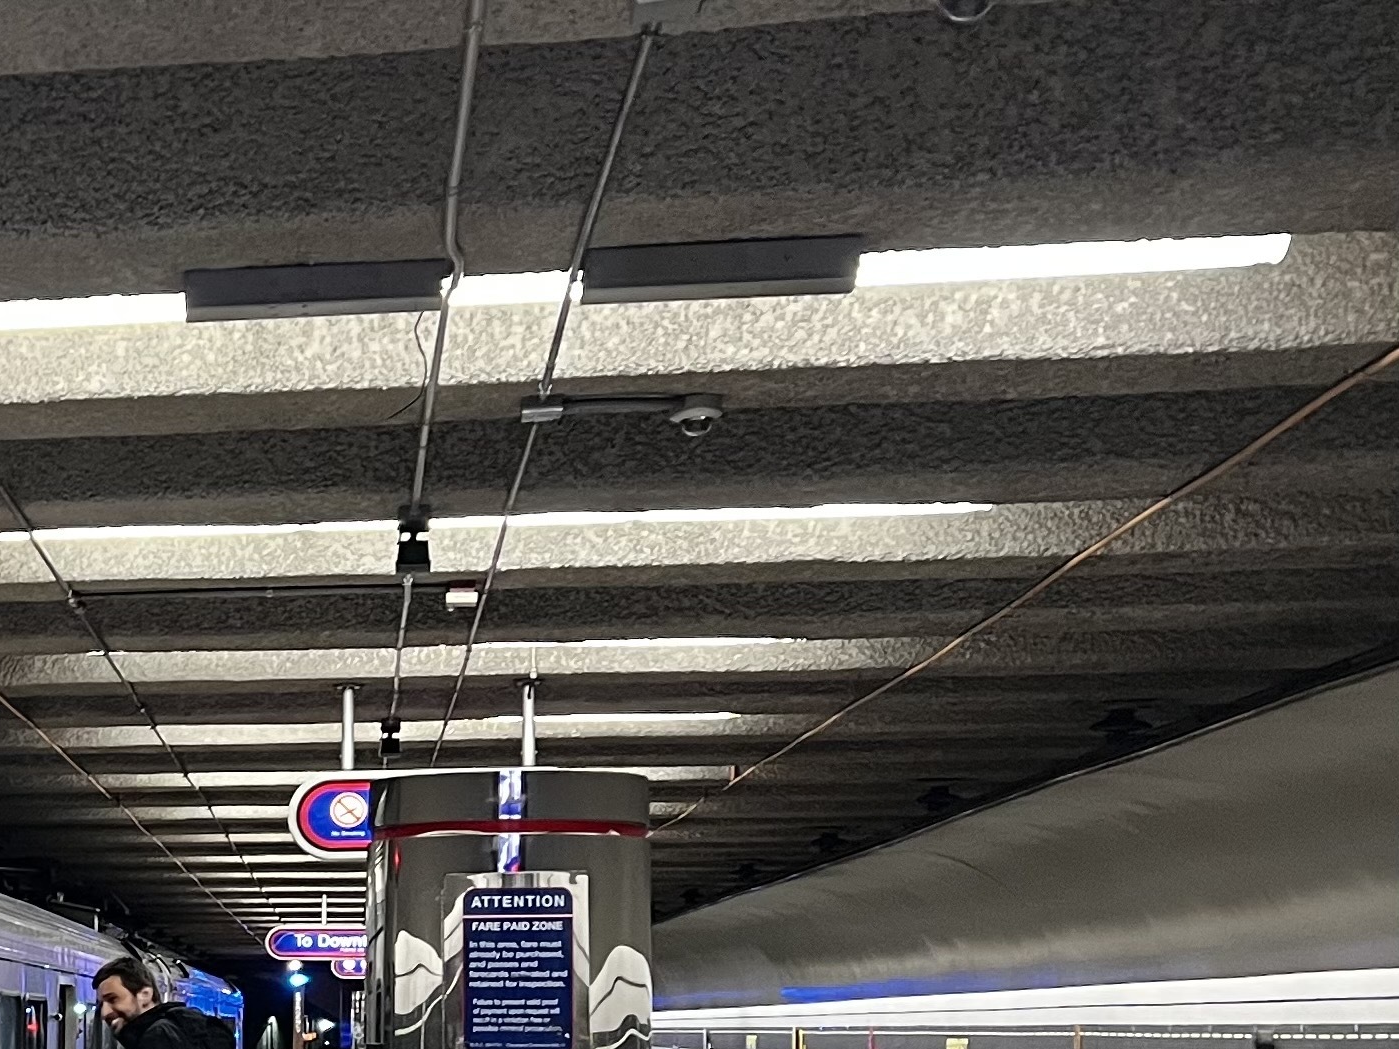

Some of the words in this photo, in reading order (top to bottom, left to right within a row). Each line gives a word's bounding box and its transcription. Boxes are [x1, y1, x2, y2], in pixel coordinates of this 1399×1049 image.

[471, 895, 565, 909] ATTENTION
[472, 921, 501, 931] FARE
[502, 921, 530, 931] PAID
[531, 921, 564, 931] ZONE
[294, 933, 313, 948] To
